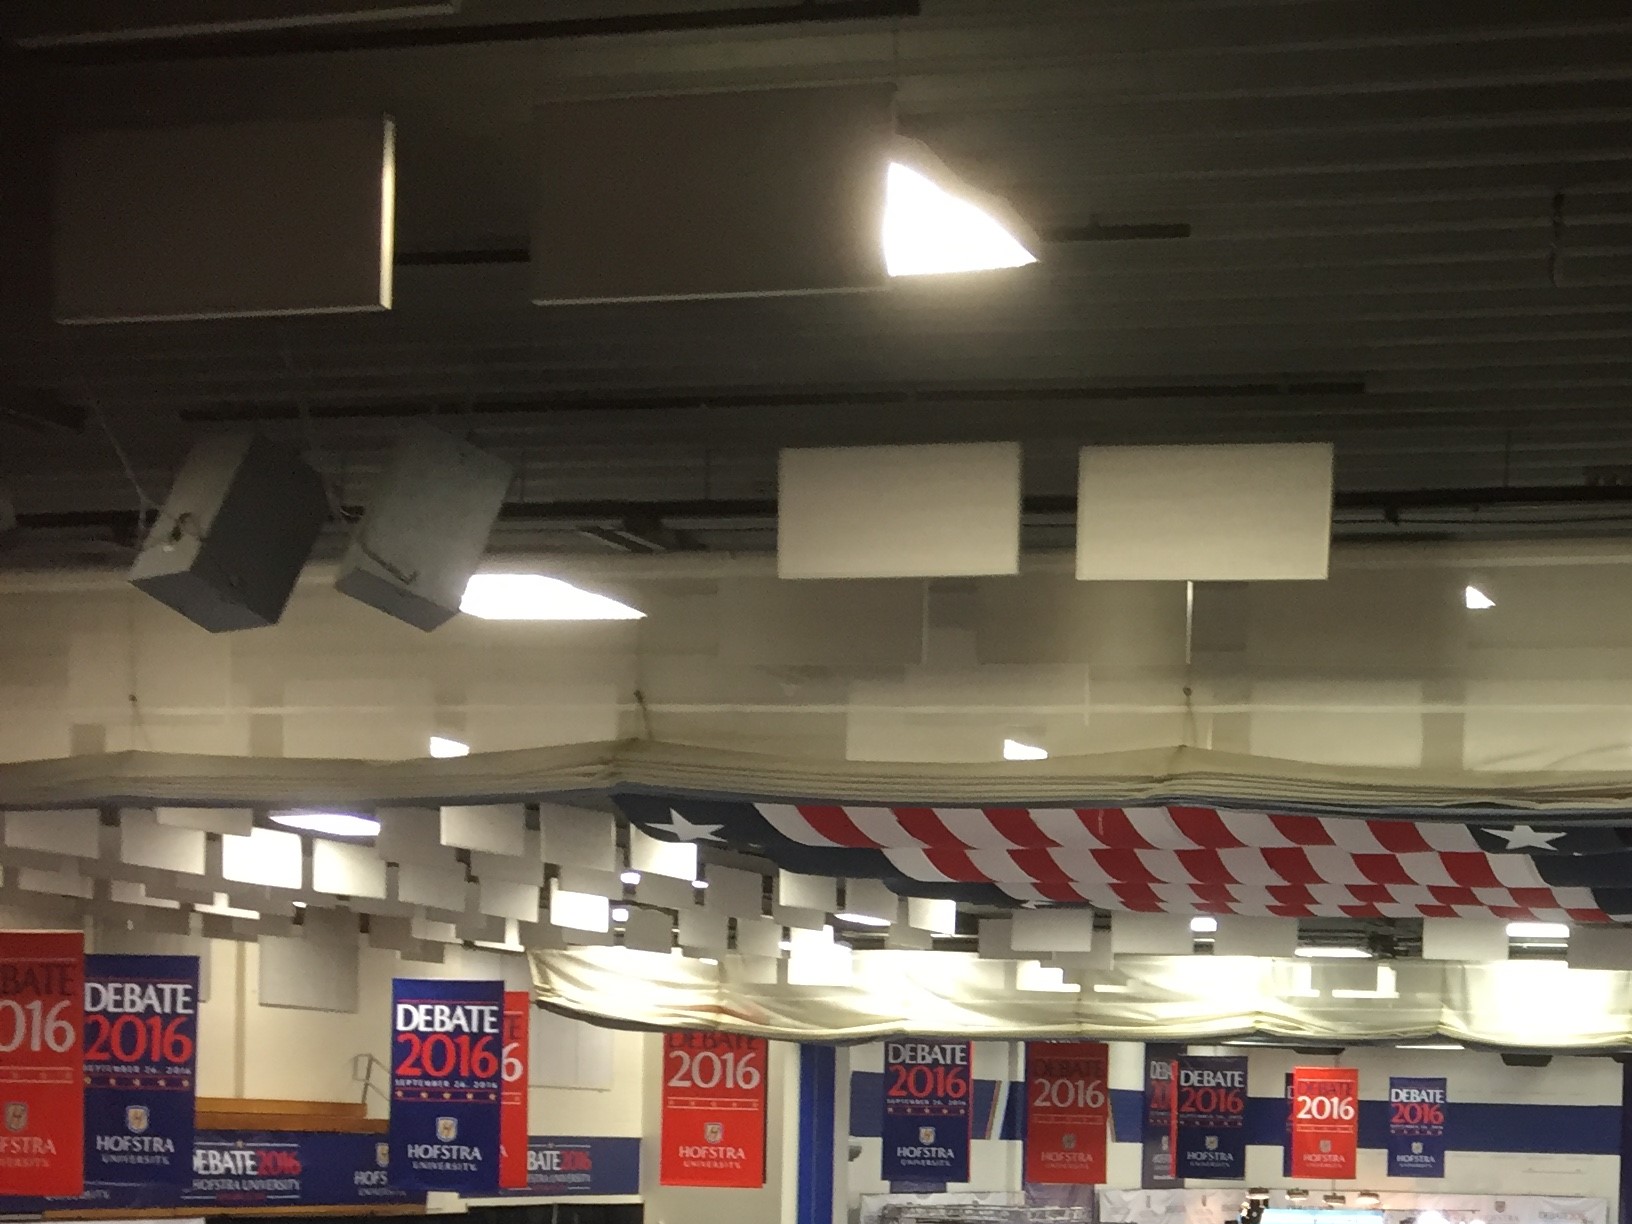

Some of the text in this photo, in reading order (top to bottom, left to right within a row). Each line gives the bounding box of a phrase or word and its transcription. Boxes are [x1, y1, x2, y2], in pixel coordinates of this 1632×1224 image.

[0, 963, 74, 996] BATE
[85, 982, 195, 1015] DEBATE
[0, 999, 76, 1052] 016
[396, 1003, 499, 1033] DEBATE
[83, 1014, 193, 1064] 2016
[395, 1032, 499, 1078] 2016
[888, 1043, 968, 1065] DEBATE
[667, 1050, 761, 1090] 2016
[888, 1064, 967, 1098] 2016
[1181, 1071, 1245, 1087] DEBATE
[1033, 1078, 1105, 1108] 2016
[1180, 1087, 1244, 1114] 2016
[1391, 1088, 1445, 1103] DEBATE
[1296, 1095, 1355, 1120] 2016
[1391, 1103, 1445, 1125] 2016
[0, 1136, 57, 1155] FSTRA
[96, 1136, 175, 1153] HOFSTRA
[407, 1144, 482, 1161] HOFSTRA
[678, 1145, 746, 1160] HOFSTRA
[896, 1146, 955, 1159] HOFSTRA
[1041, 1151, 1094, 1162] HOFSTRA
[1187, 1151, 1234, 1161] HOFSTRA
[354, 1170, 388, 1186] HOFS
